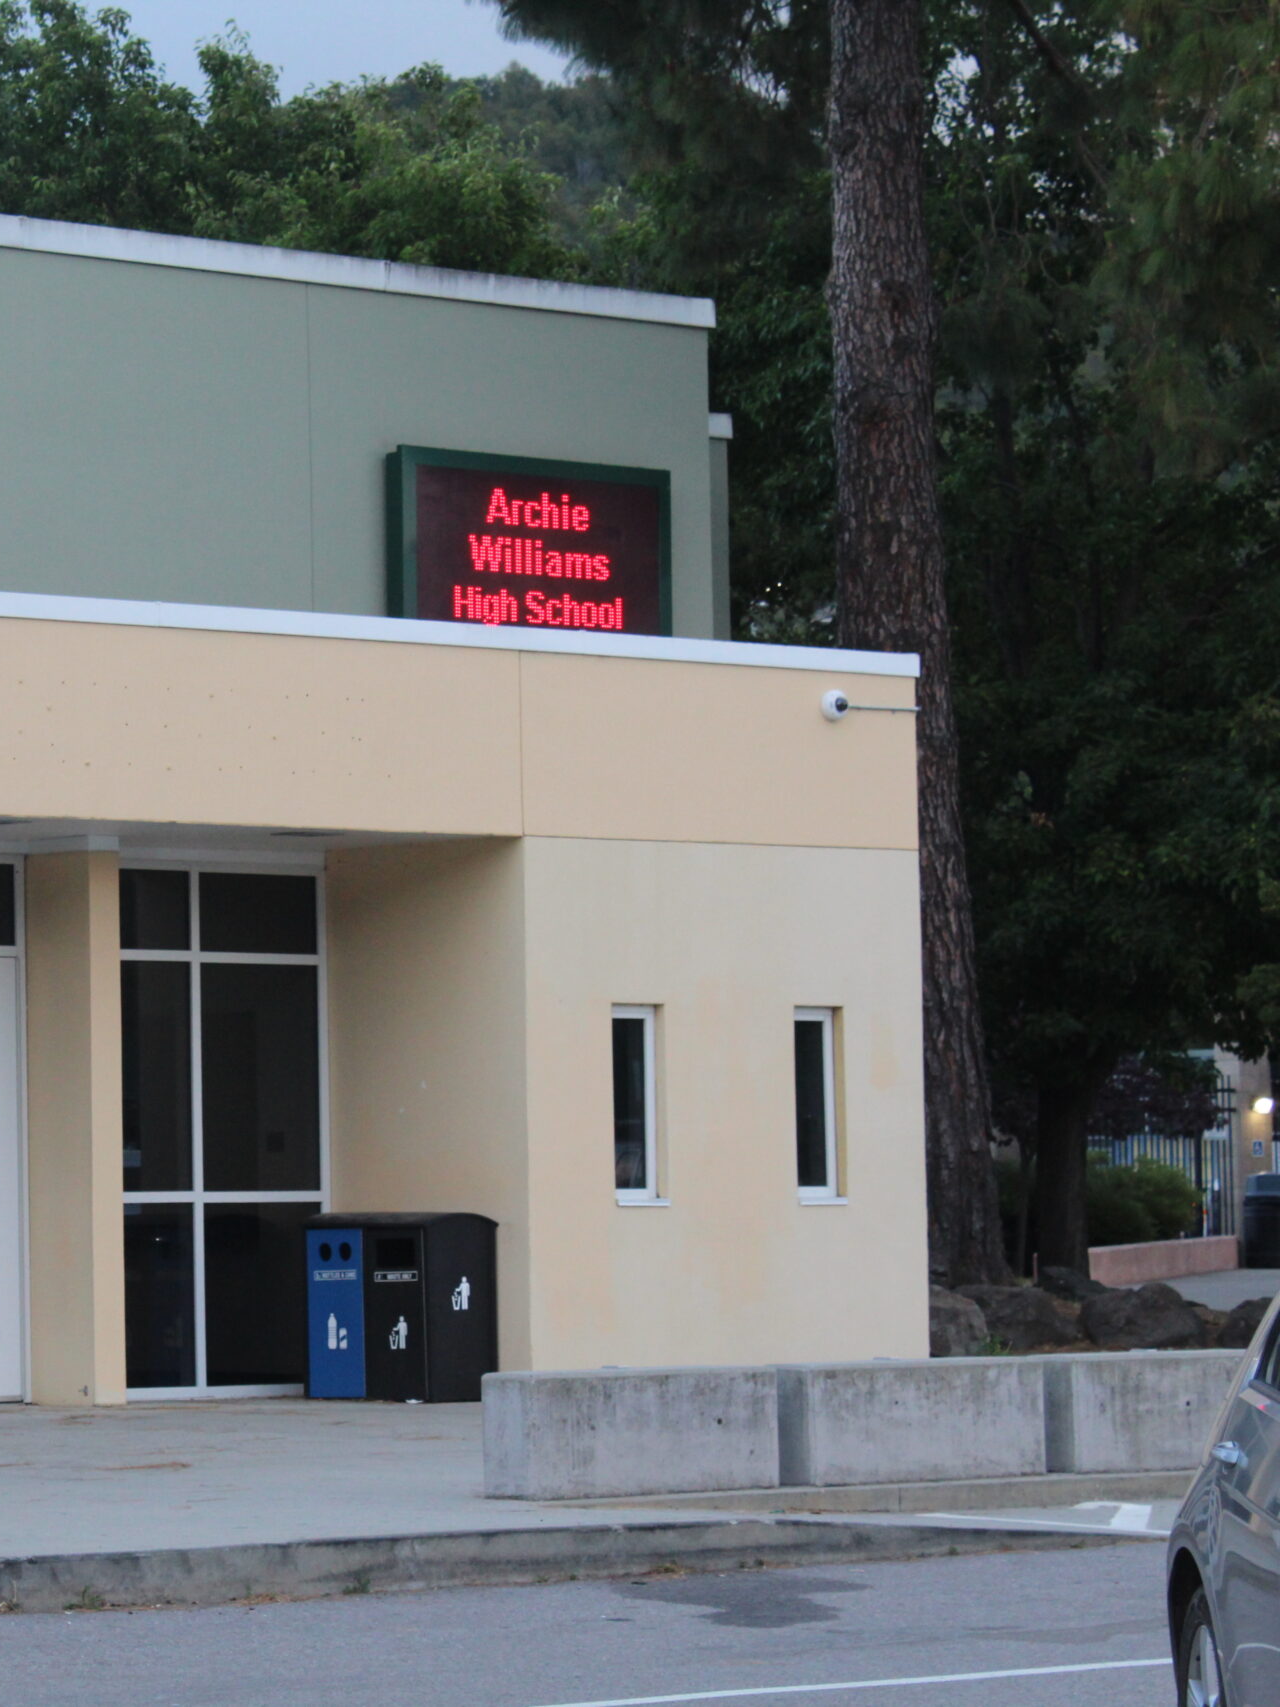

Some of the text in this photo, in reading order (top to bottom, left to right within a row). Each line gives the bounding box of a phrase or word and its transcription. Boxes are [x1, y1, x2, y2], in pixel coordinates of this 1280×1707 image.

[486, 488, 590, 531] Archie
[468, 533, 610, 581] Williams
[453, 585, 623, 629] High School
